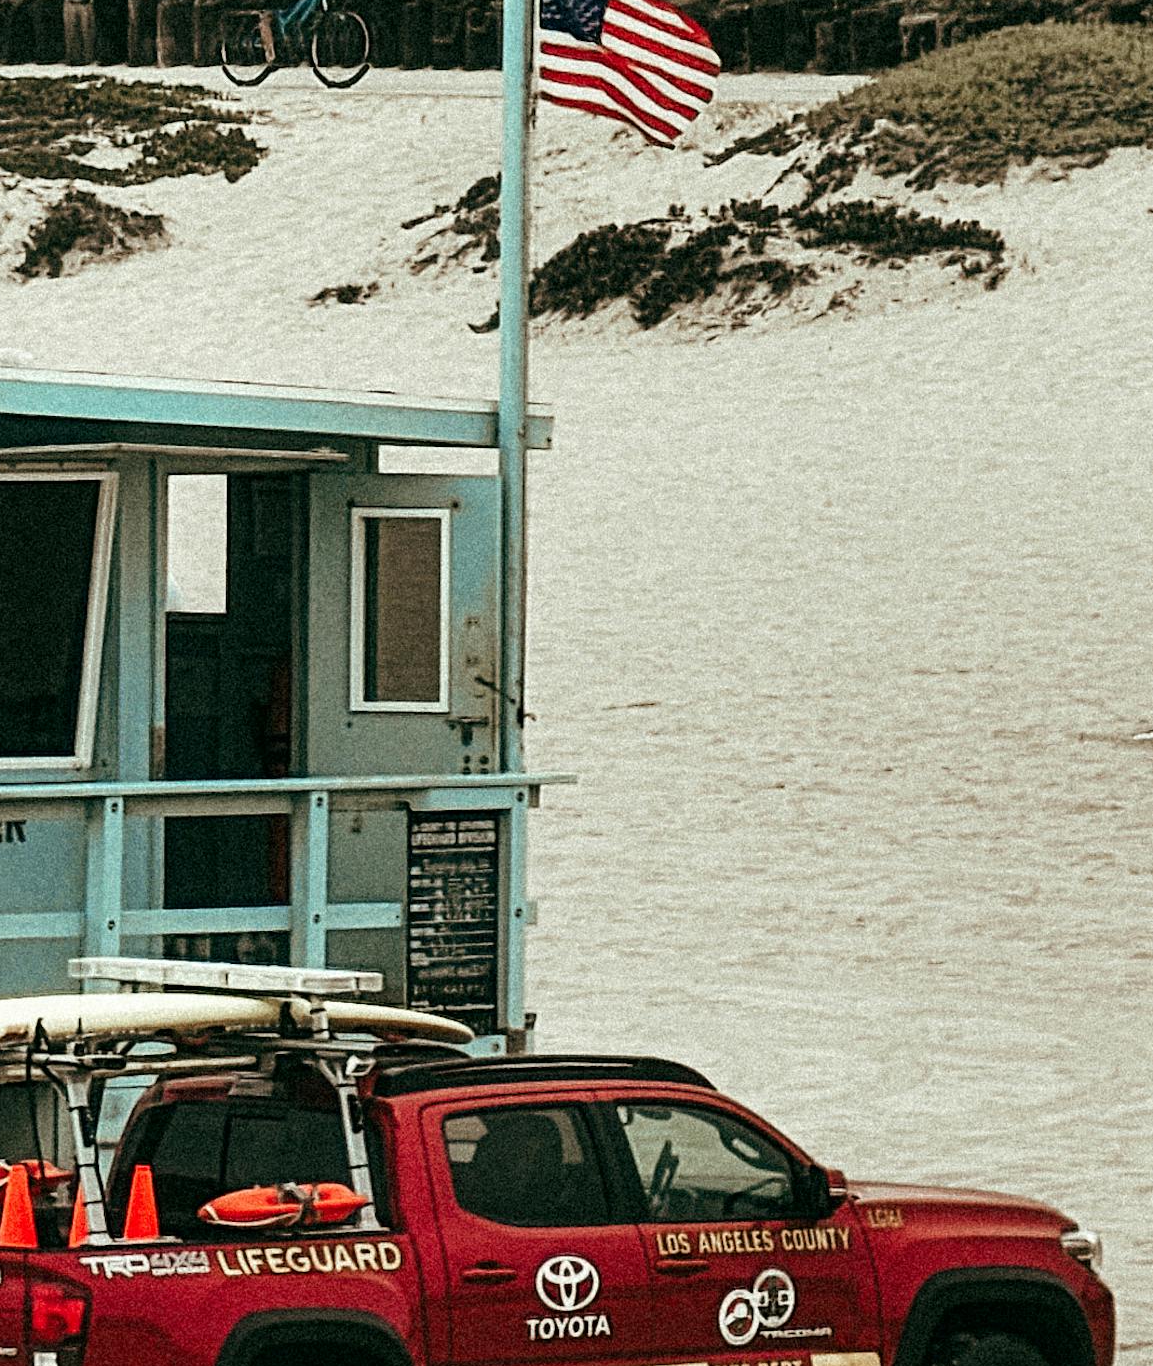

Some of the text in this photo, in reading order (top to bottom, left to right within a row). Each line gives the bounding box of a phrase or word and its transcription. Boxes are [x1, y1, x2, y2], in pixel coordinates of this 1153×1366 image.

[656, 1226, 849, 1256] LOS ANGELES COUNTY
[216, 1241, 403, 1277] LIFEGUARD
[526, 1315, 611, 1340] TOYOTA
